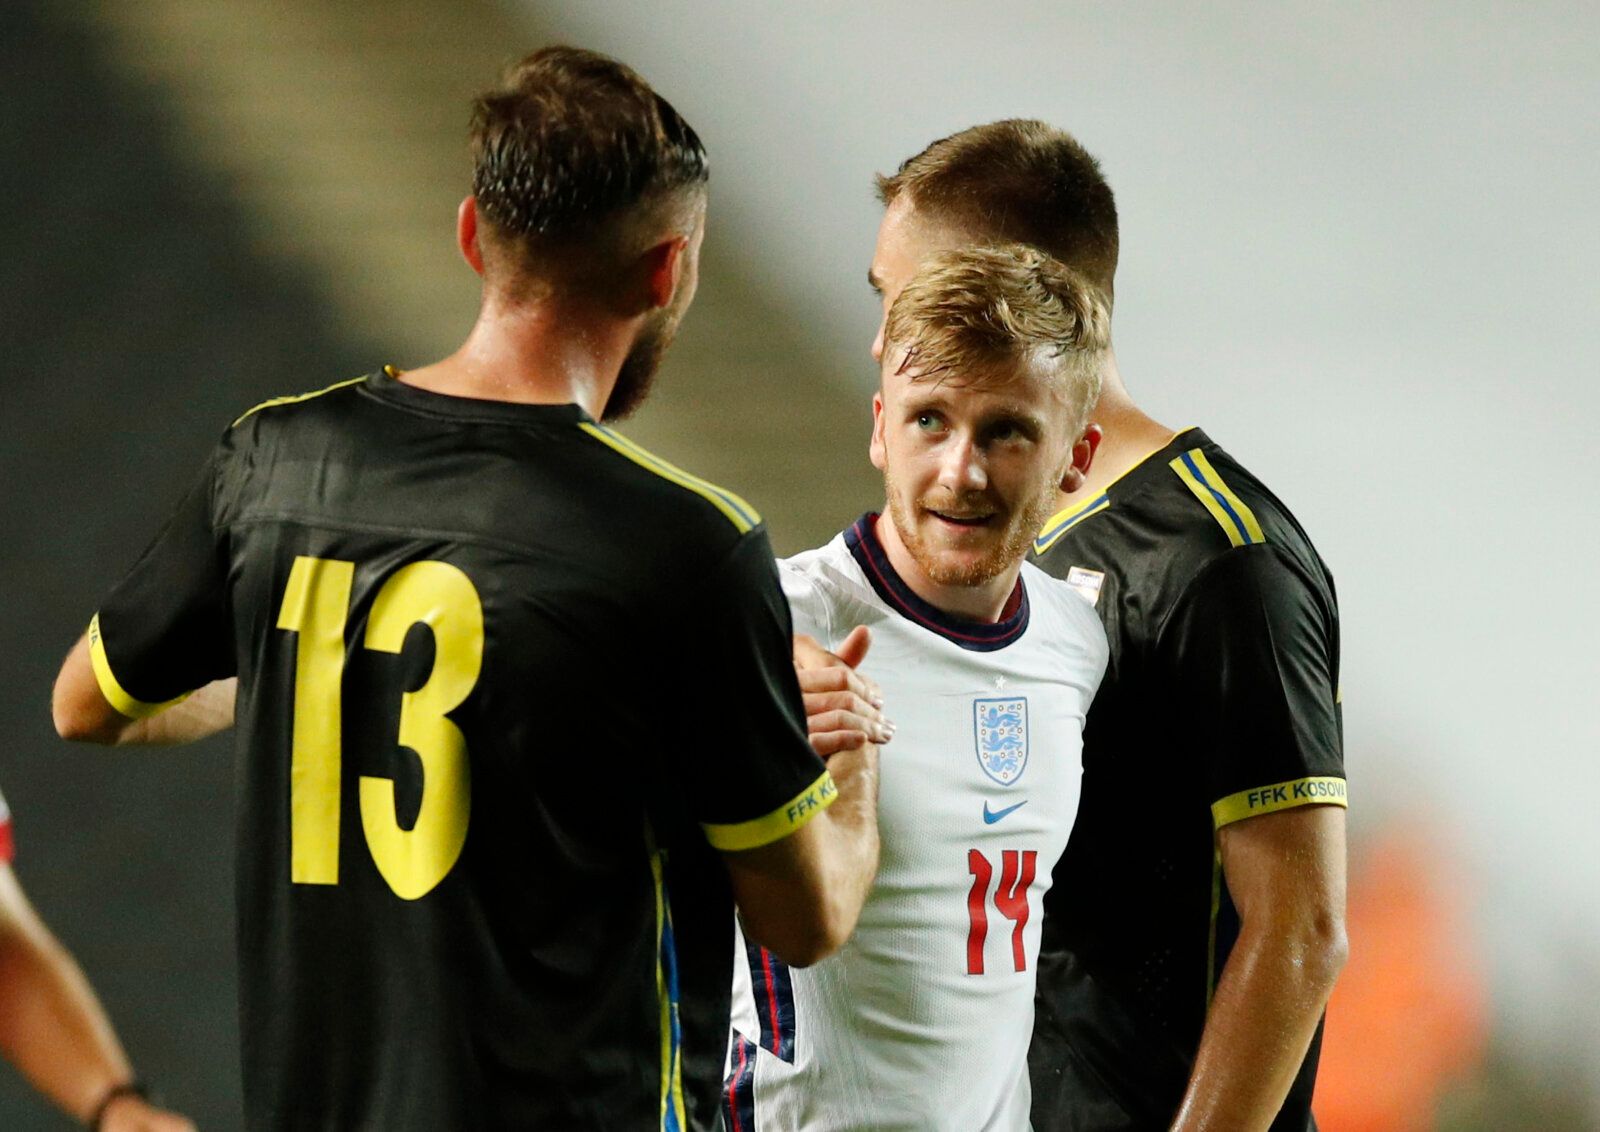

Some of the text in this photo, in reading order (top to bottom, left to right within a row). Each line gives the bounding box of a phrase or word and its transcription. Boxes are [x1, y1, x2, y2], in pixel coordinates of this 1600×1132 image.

[276, 555, 485, 900] 13
[787, 791, 819, 823] FFK
[1247, 786, 1288, 809] FFK
[967, 848, 1038, 975] 14
